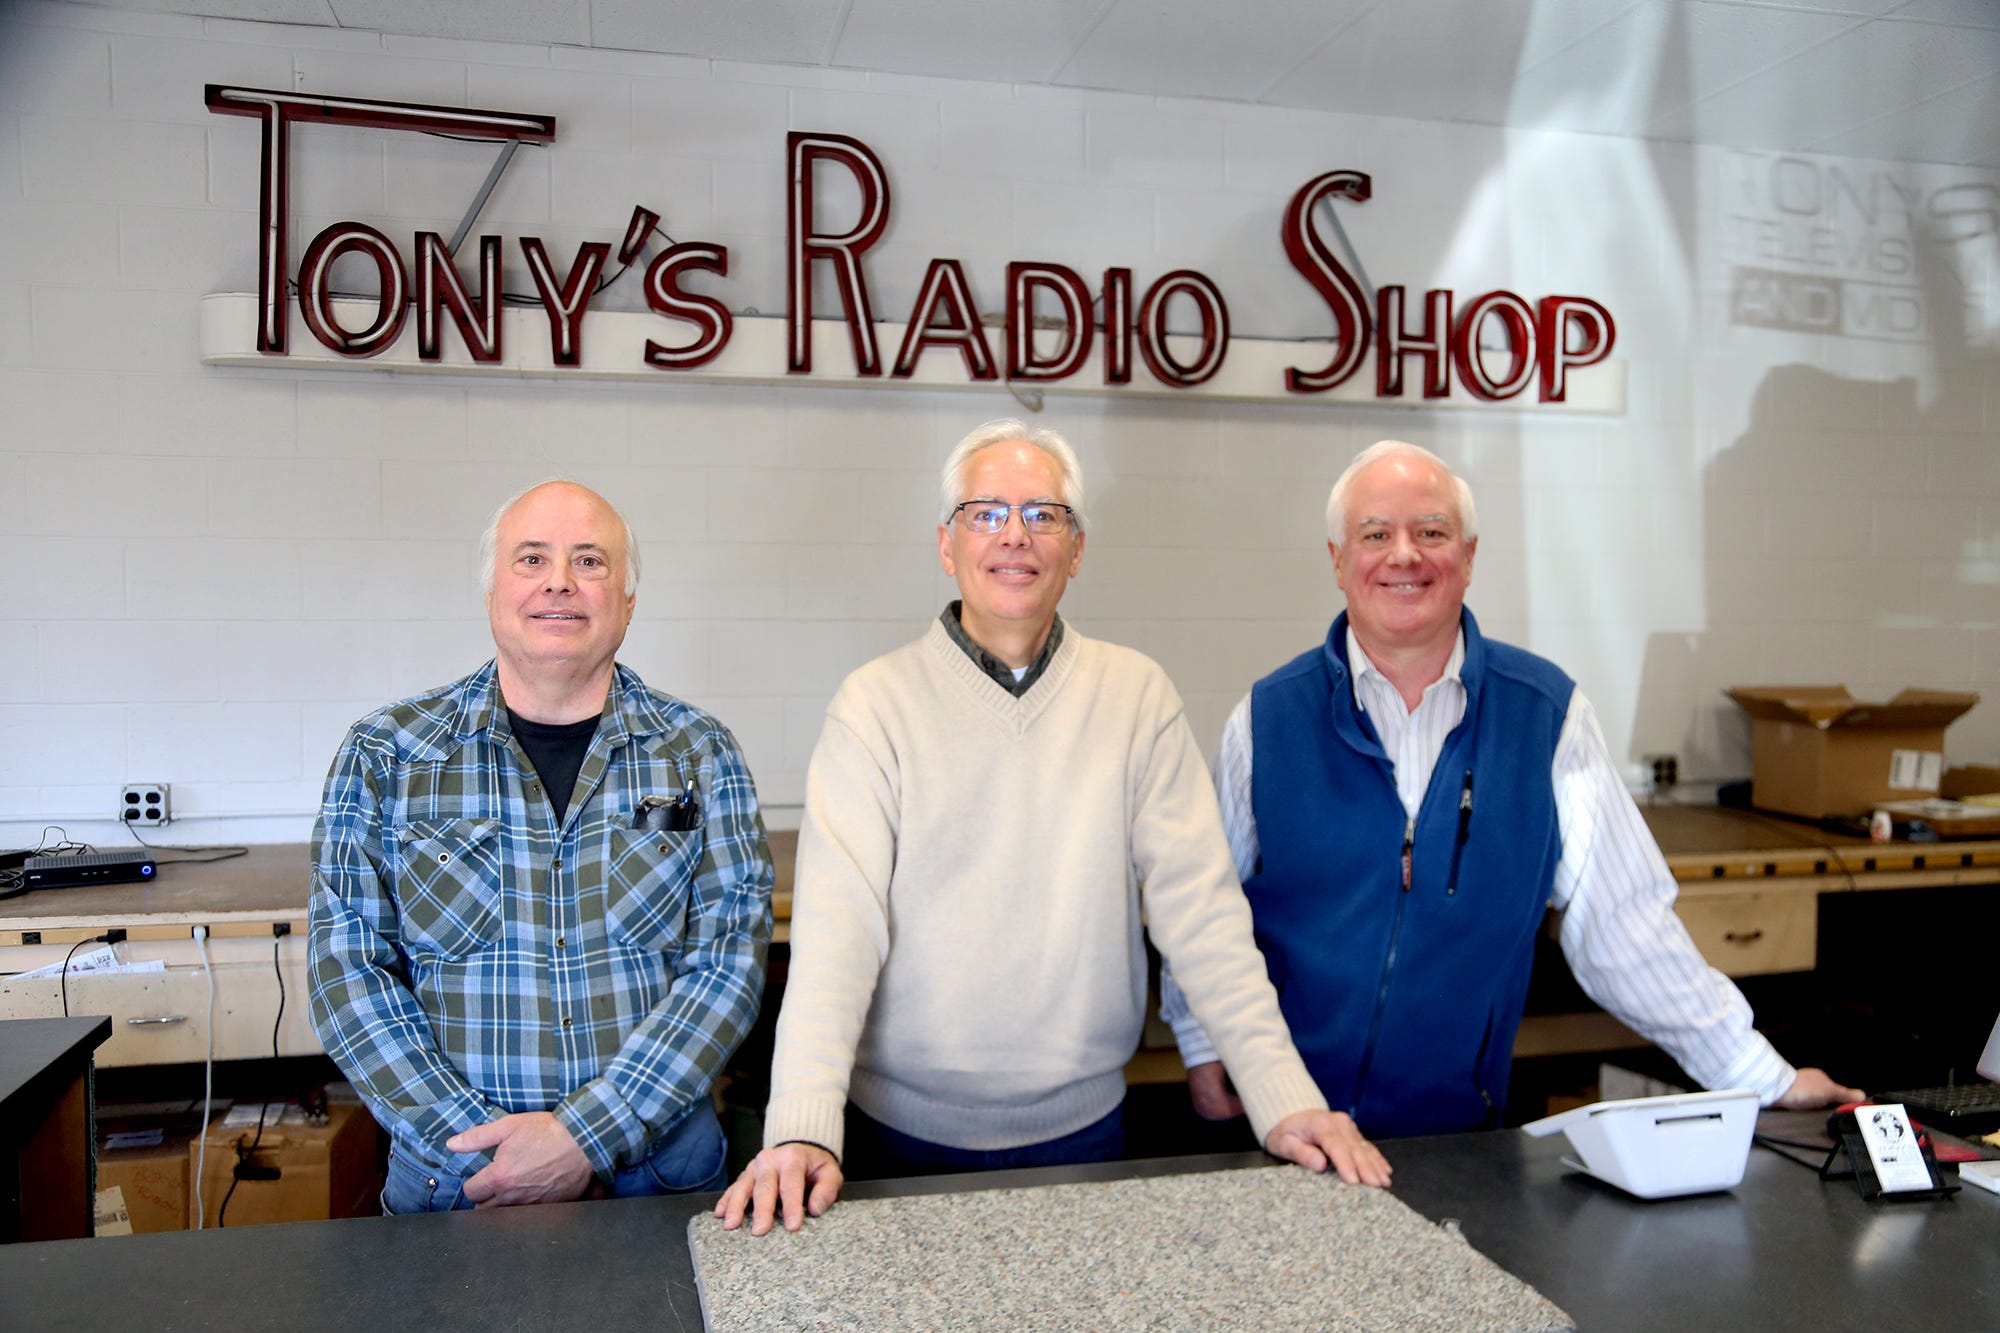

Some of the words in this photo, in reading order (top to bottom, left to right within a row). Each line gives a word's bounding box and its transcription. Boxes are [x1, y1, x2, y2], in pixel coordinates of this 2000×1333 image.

[204, 84, 733, 370] TONY'S
[787, 131, 1229, 388] RADIO
[1281, 169, 1615, 403] SHOP
